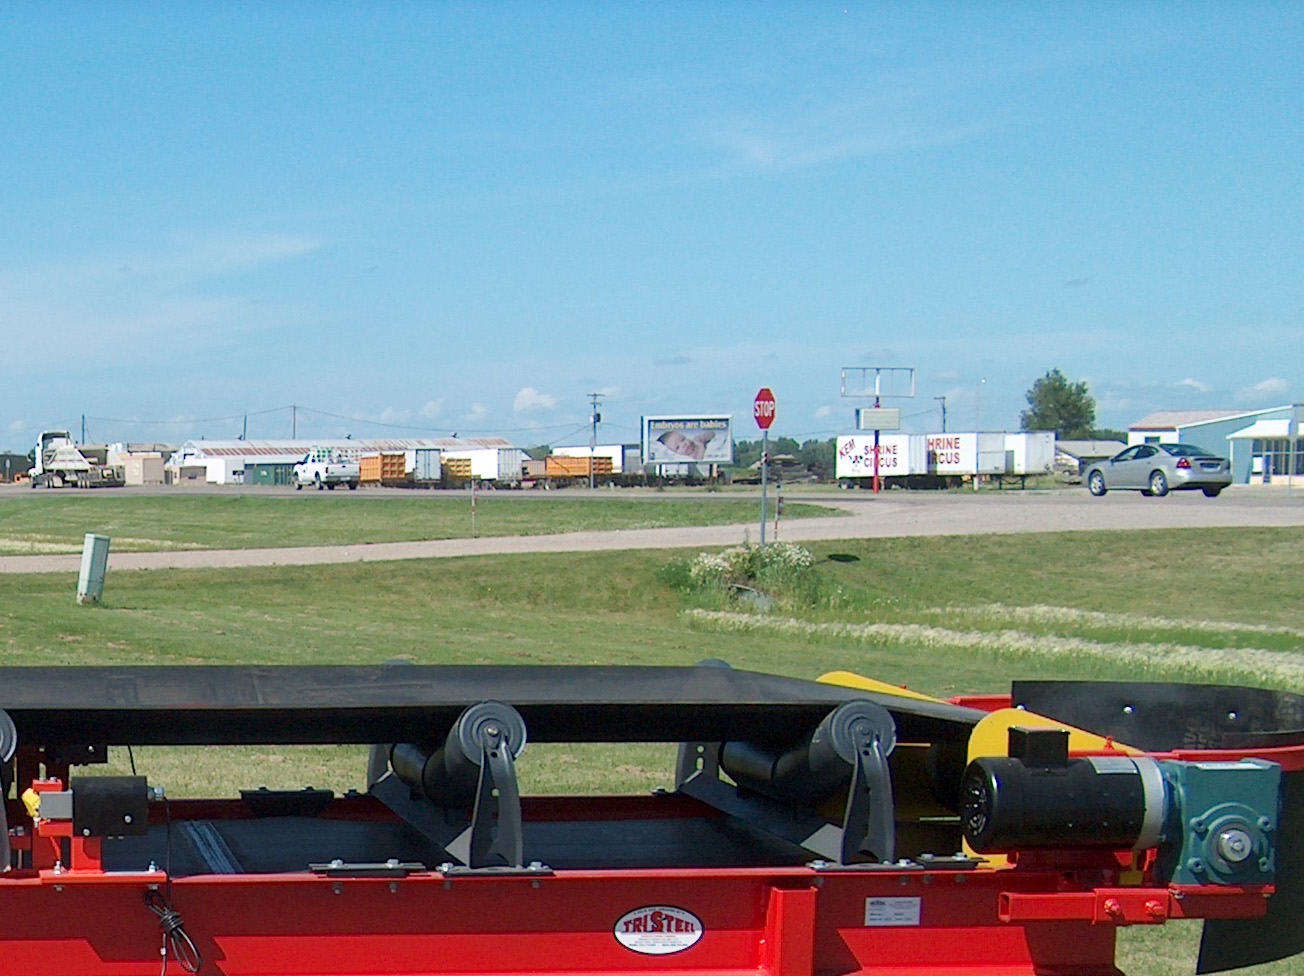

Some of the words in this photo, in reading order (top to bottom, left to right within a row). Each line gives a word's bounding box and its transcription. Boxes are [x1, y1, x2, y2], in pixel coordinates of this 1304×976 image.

[755, 401, 774, 417] STOP
[651, 421, 684, 431] Embryos
[685, 422, 699, 430] are
[700, 420, 727, 430] babies
[927, 437, 960, 450] HRINE
[864, 457, 898, 468] CICUS
